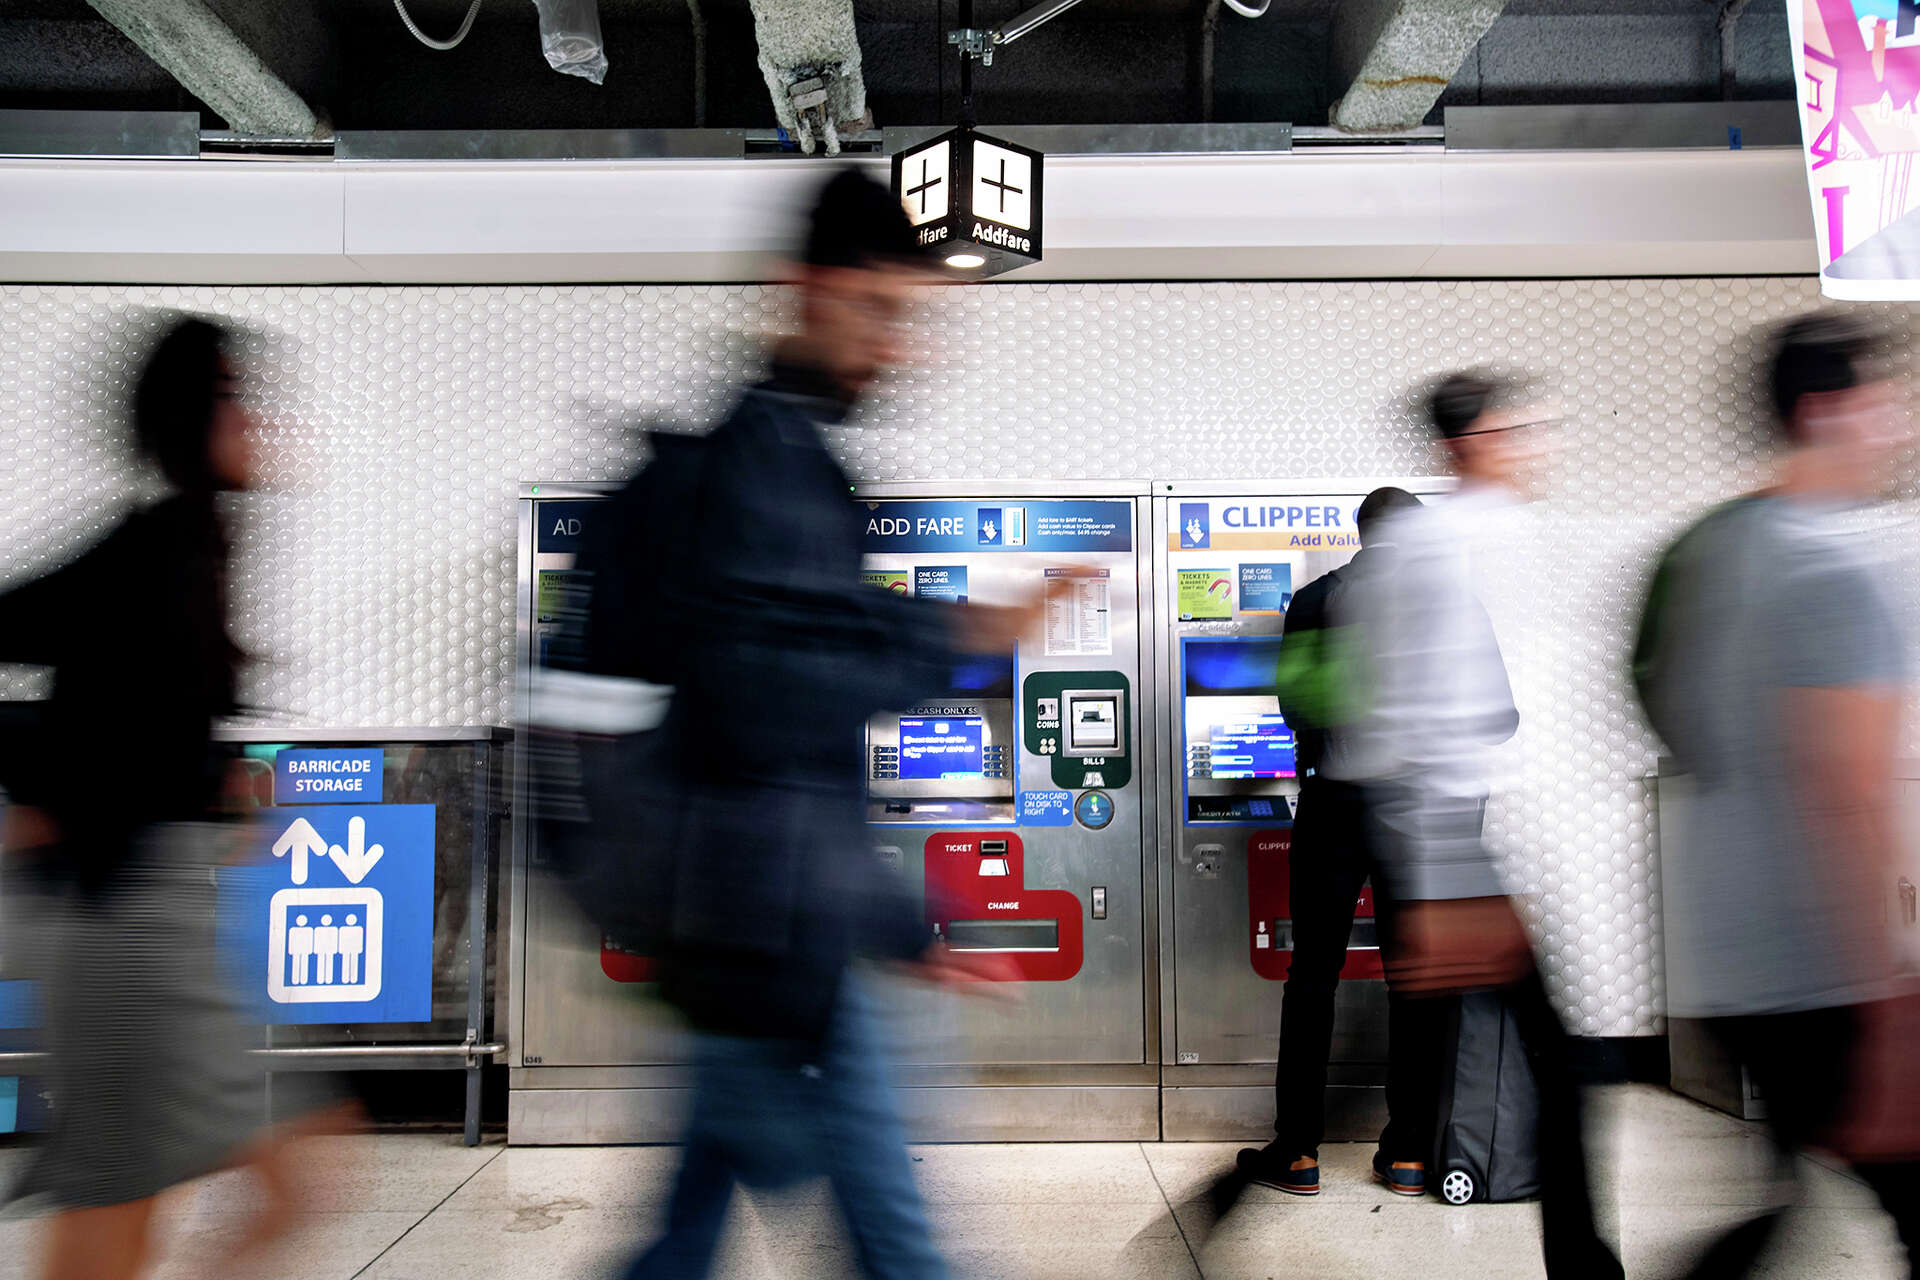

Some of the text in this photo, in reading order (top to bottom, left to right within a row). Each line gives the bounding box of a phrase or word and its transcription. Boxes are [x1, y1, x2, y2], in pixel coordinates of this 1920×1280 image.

[971, 222, 1031, 253] Addfare
[1222, 506, 1341, 528] CLIPPER
[552, 518, 583, 536] AD
[866, 517, 965, 536] ADD FARE
[1289, 534, 1361, 547] Add Valu
[544, 574, 569, 582] TICKET
[917, 707, 942, 715] CASH
[1036, 720, 1060, 729] COINS
[1083, 757, 1105, 765] BILLS
[287, 759, 372, 774] BARRICADE
[295, 777, 364, 792] STORAGE
[1024, 792, 1069, 800] TOUCH CARD
[1024, 800, 1063, 808] ON DISK TO
[1024, 808, 1045, 816] RIGHT
[944, 844, 973, 852] TICKET
[987, 901, 1020, 910] CHANGE
